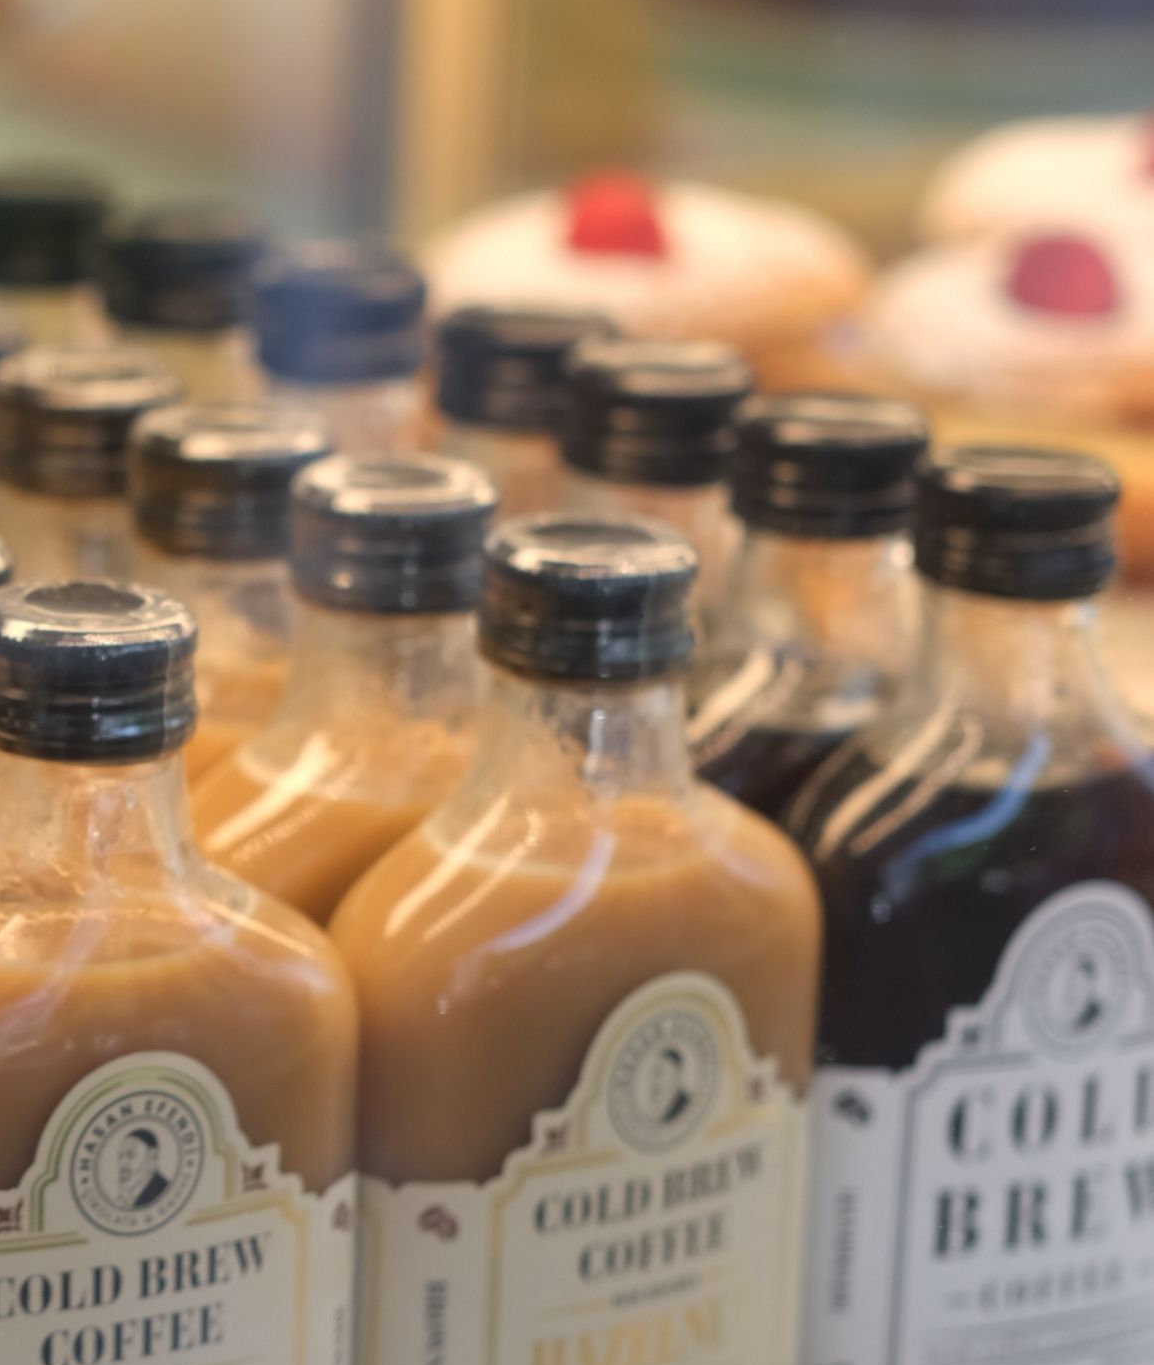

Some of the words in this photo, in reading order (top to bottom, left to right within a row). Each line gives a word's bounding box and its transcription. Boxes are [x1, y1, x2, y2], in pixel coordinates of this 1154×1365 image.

[79, 1102, 134, 1171] HASAN
[533, 1178, 652, 1238] COLD
[661, 1137, 769, 1211] BREW
[138, 1230, 272, 1301] BREW
[577, 1205, 730, 1284] COFFEE
